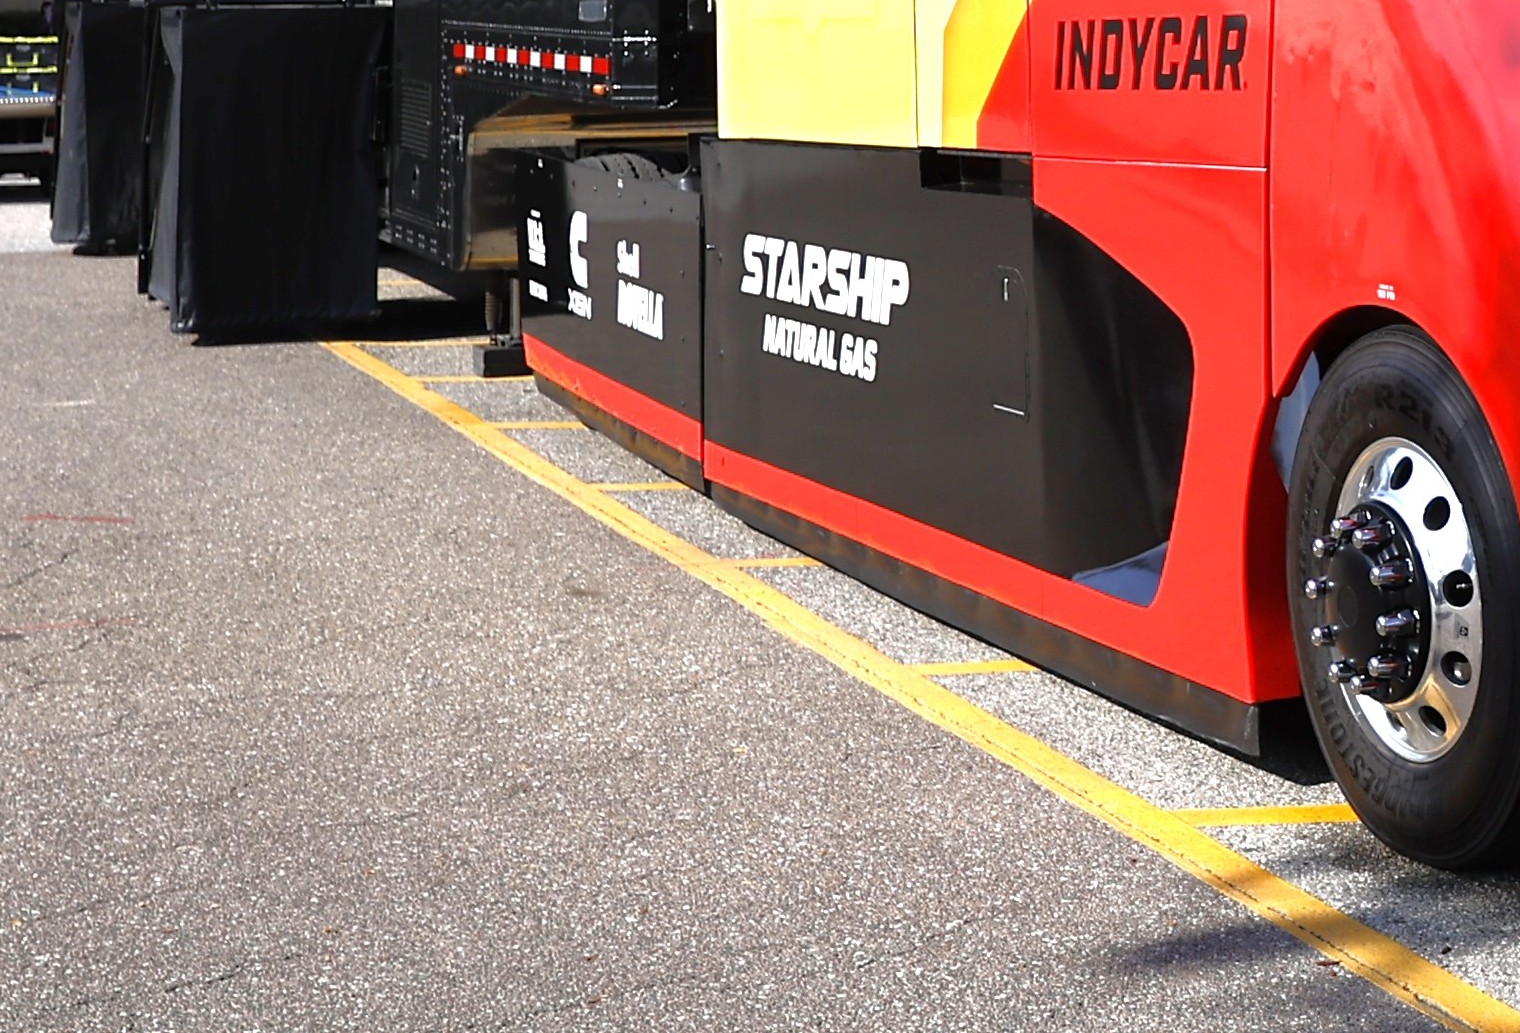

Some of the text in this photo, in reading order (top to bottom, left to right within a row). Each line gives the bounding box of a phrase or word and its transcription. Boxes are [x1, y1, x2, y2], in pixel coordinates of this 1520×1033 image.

[1055, 14, 1247, 91] INDYCAR
[740, 233, 910, 326] STARSHIP
[762, 313, 878, 382] NATURAL GAS
